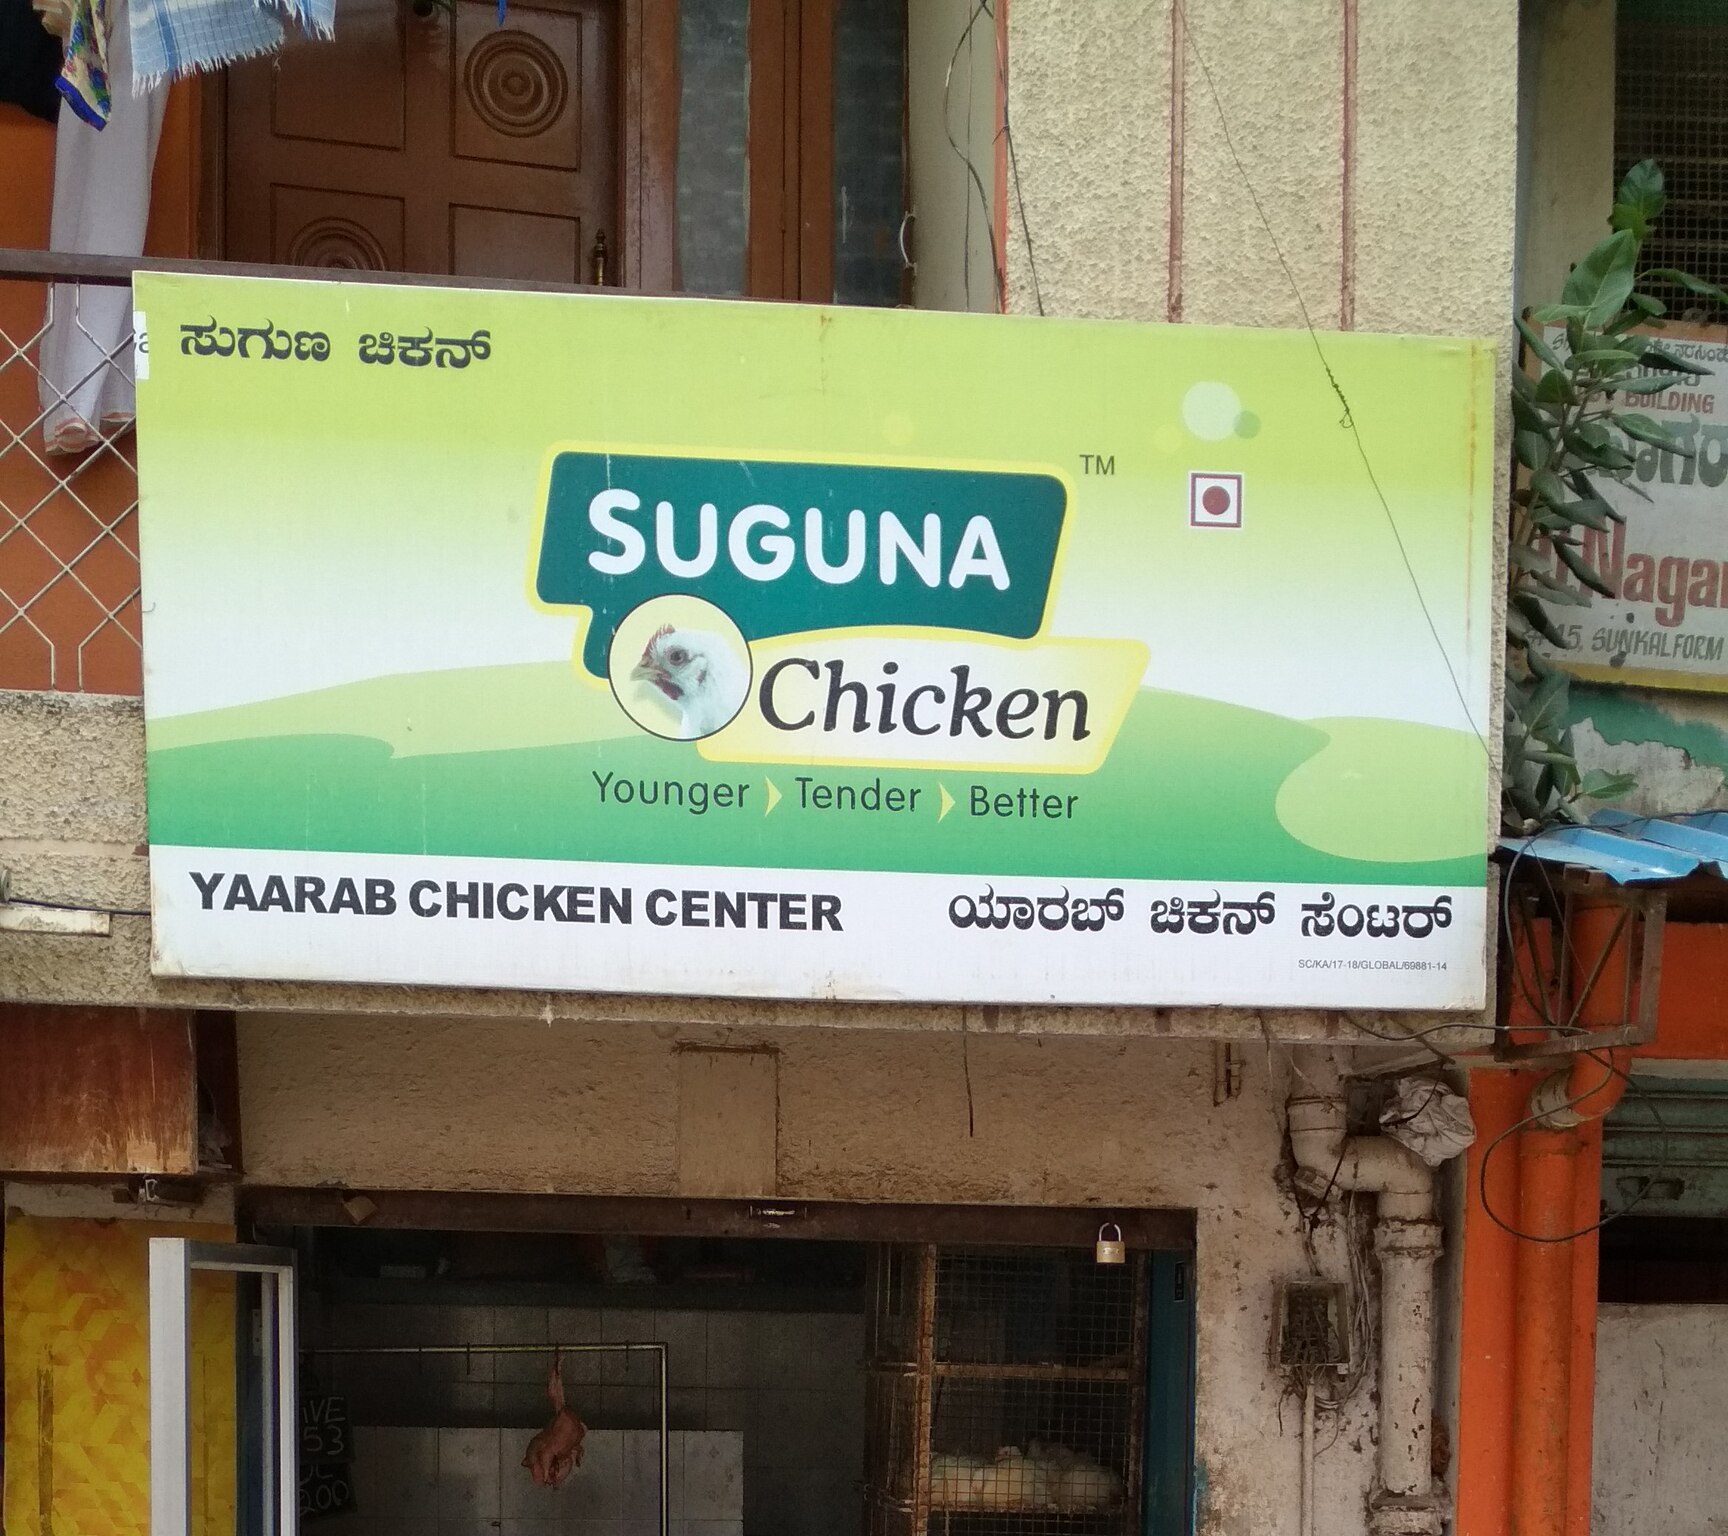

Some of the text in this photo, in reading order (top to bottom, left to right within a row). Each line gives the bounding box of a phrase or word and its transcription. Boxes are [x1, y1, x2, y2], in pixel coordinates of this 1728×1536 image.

[180, 314, 331, 361] ಸುಗುಣ
[358, 326, 491, 369] ಚಿಕನ್
[1624, 390, 1715, 414] BUILDING
[1080, 454, 1115, 475] TM
[588, 488, 1010, 591] SUGUNA
[758, 657, 1092, 741] Chicken
[592, 771, 1079, 819] Younger Tender Better
[189, 871, 844, 932] YAARAB CHICKEN CENTER
[948, 883, 1453, 939] ಯಾರಬ್ ಚಿಕನ್ ಸೆಂಟರ್
